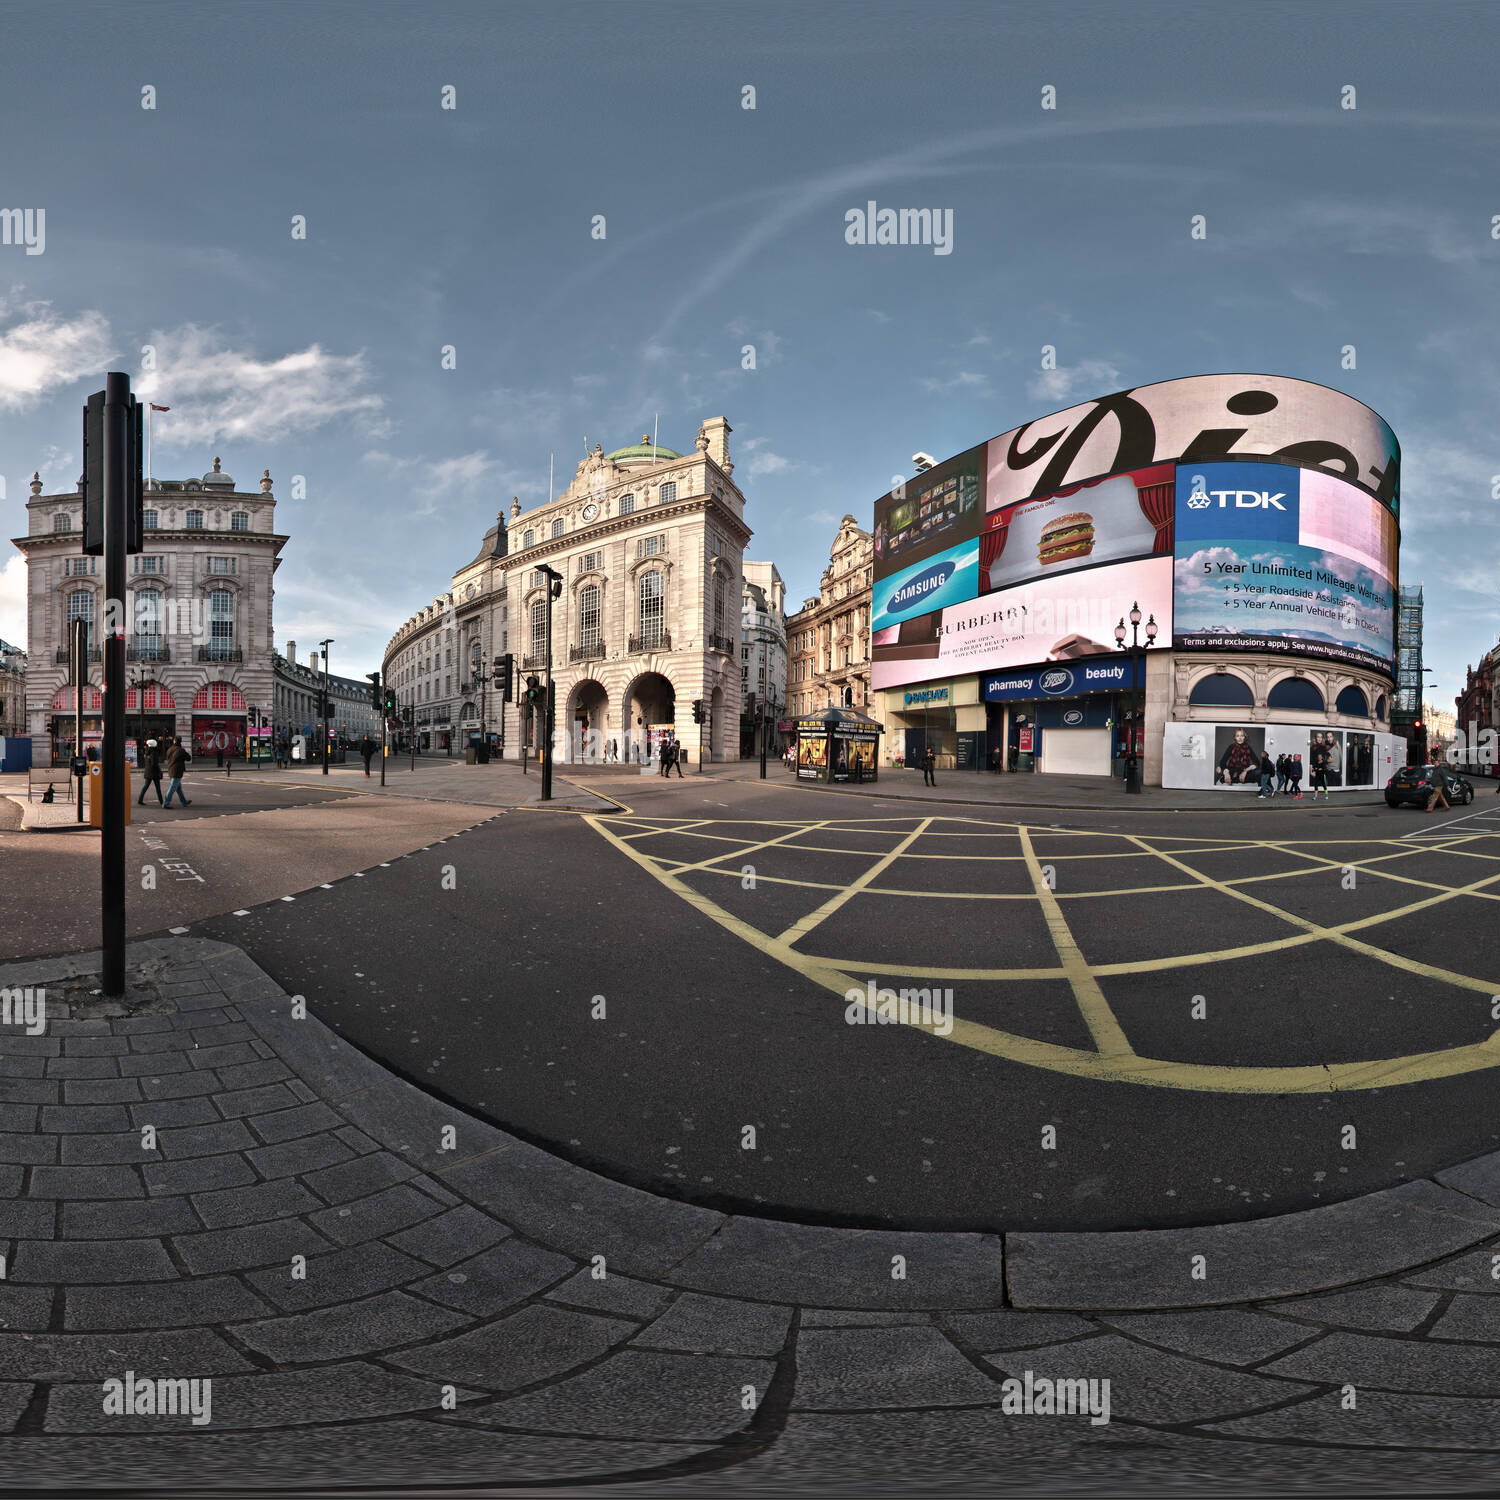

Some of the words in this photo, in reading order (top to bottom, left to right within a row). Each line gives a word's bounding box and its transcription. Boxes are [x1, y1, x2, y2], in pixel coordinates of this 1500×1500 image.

[1210, 490, 1287, 511] TDK
[894, 573, 945, 603] SAMSUNG
[1204, 562, 1212, 574] 5
[1217, 562, 1247, 574] Year
[1252, 562, 1313, 580] Unlimited
[1316, 571, 1355, 592] Mileage
[1358, 583, 1388, 610] Warranty
[1233, 584, 1240, 593] 5
[1243, 584, 1267, 593] Year
[1269, 585, 1313, 600] Roadside
[1316, 591, 1356, 608] Assistance
[936, 605, 1029, 638] BURBERRY
[1233, 599, 1240, 609] 5
[1243, 600, 1267, 609] Year
[1269, 601, 1303, 613] Annual
[1306, 605, 1336, 619] Vehicle
[1338, 613, 1360, 627] Heah
[1360, 619, 1380, 634] Checks
[1183, 637, 1206, 645] Terms
[1207, 637, 1223, 646] and
[1224, 637, 1265, 647] exclusions
[1267, 639, 1290, 650] apply.
[1292, 641, 1306, 650] See
[1042, 673, 1067, 688] Boots
[1086, 666, 1125, 680] beauty
[912, 687, 949, 704] BARCLAYS
[988, 678, 1034, 693] pharmacy
[203, 730, 230, 751] 70
[158, 857, 206, 882] LEFT
